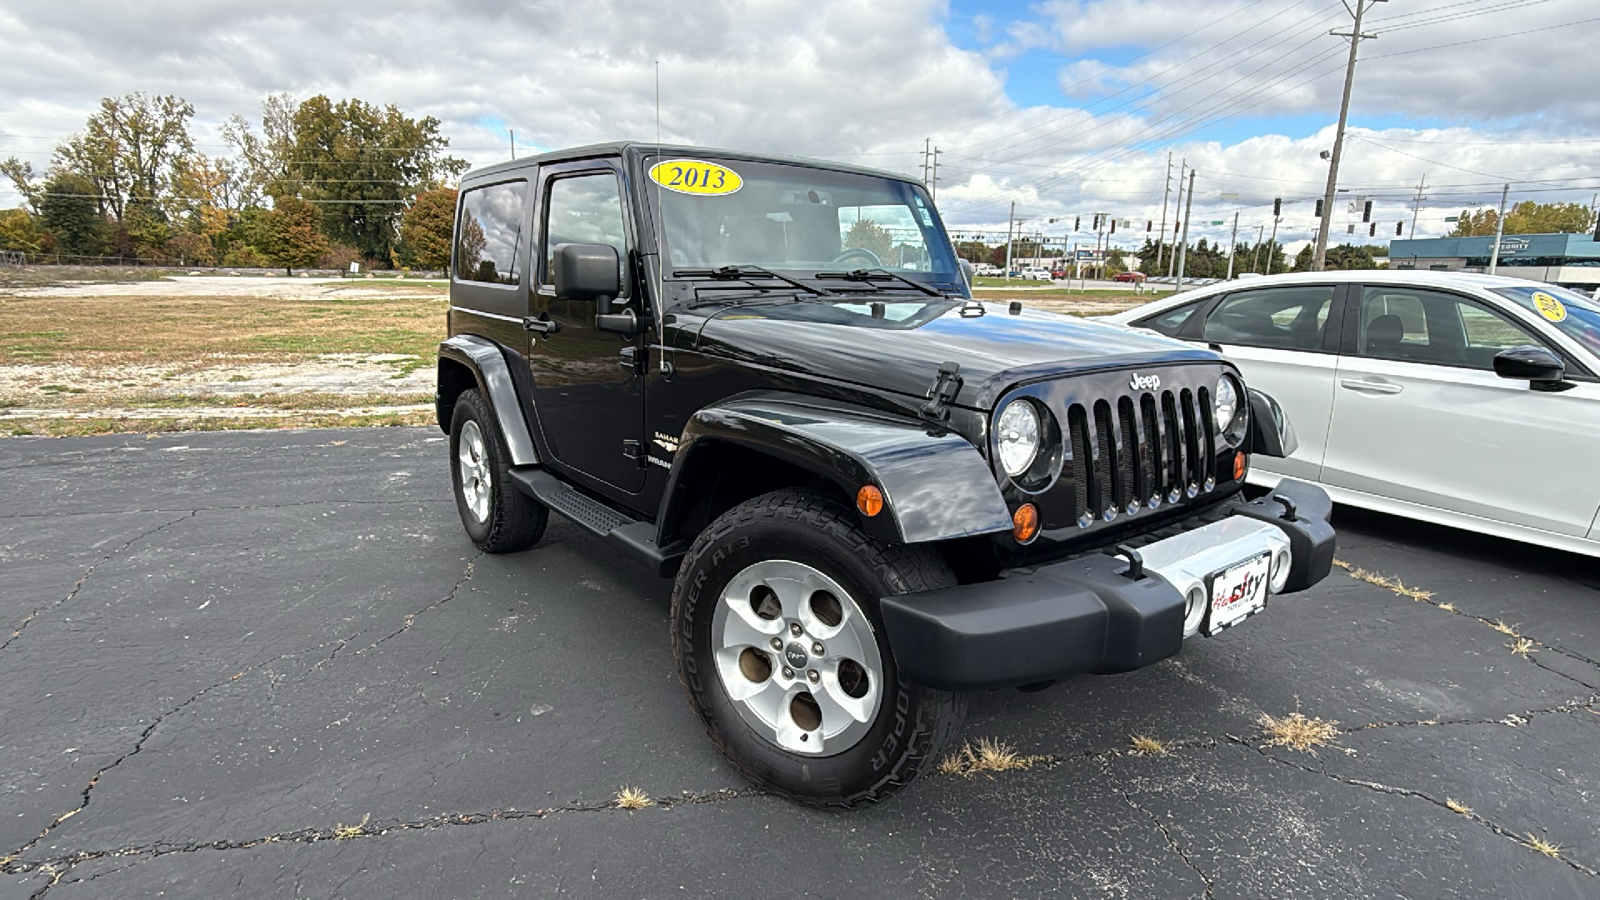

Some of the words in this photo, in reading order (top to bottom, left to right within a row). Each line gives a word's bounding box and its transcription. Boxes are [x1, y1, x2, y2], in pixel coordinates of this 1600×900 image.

[668, 166, 726, 189] 2013
[1129, 372, 1161, 391] Jeep
[654, 431, 679, 444] SAHAR
[712, 535, 751, 566] AT3
